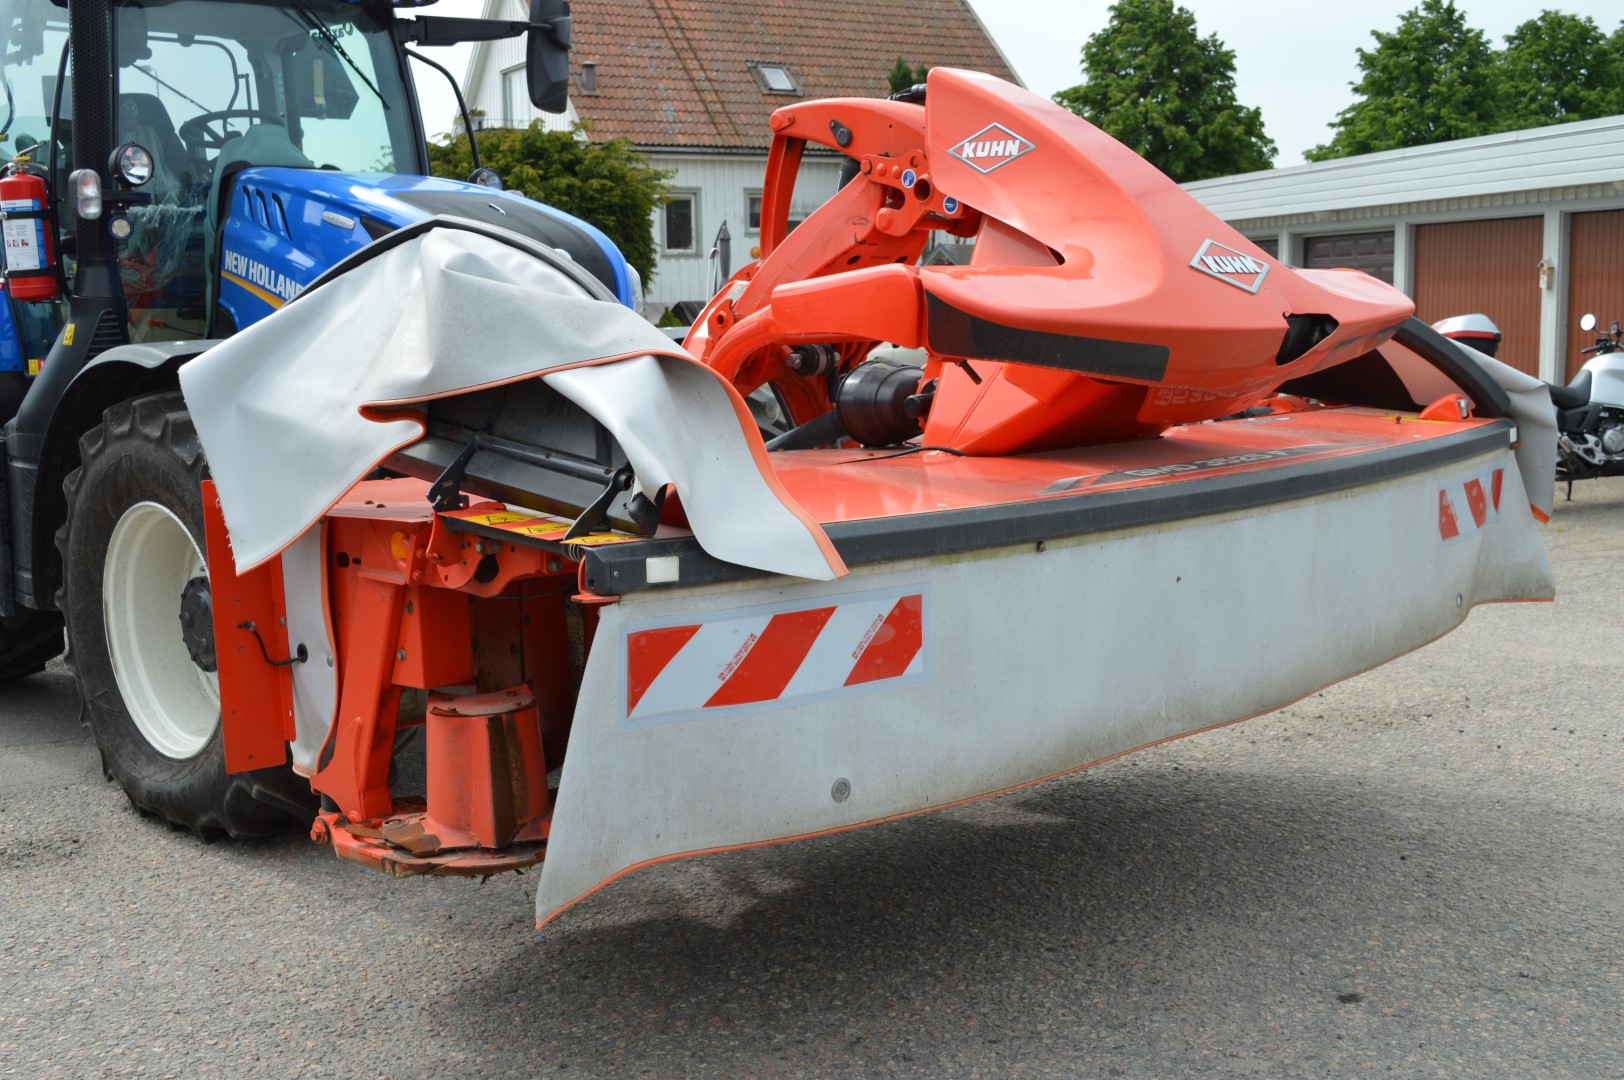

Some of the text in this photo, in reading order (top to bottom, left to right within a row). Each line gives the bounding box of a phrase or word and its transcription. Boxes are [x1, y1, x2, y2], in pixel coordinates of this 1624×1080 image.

[962, 140, 1020, 158] KUHN
[225, 250, 248, 277] NEW
[1200, 255, 1262, 274] KUHN
[1123, 464, 1199, 476] GMD
